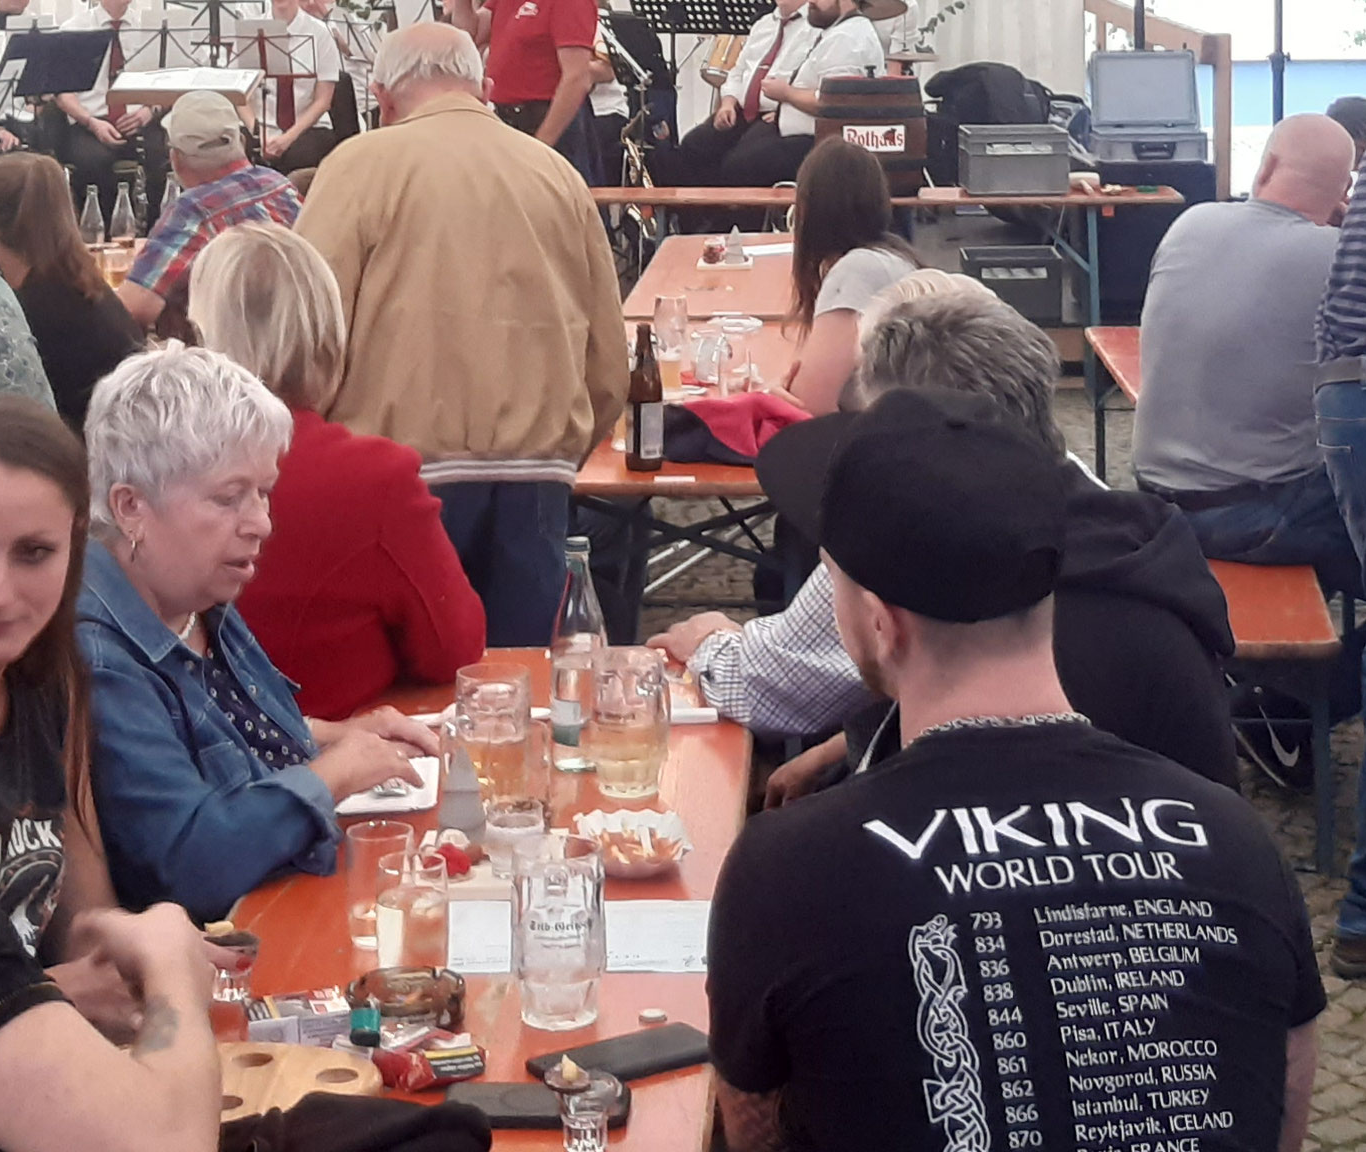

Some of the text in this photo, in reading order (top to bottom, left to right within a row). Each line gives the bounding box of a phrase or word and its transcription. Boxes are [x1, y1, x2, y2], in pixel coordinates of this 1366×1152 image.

[862, 797, 1208, 859] VIKING
[934, 851, 1183, 894] WORLD TOUR
[970, 898, 1213, 930] 793 Lindisfarne, ENGLAND
[975, 922, 1238, 953] 834 Dorestad, NETHERLANDS
[979, 946, 1200, 978] 836 Antwerp, BELGIUM
[983, 969, 1185, 1002] 838 Dublin, IRELAND
[987, 993, 1169, 1026] 844 Seville, SPAIN
[992, 1017, 1156, 1050] 860 Pisa, ITALY
[997, 1040, 1217, 1075] 861 Nekor, MOROCCO
[1001, 1063, 1217, 1099] 862 Novgorod, RUSSIA
[1005, 1088, 1210, 1124] 866 Istanbul, TURKEY
[1008, 1111, 1234, 1149] 870 Reykjavik, ICELAND
